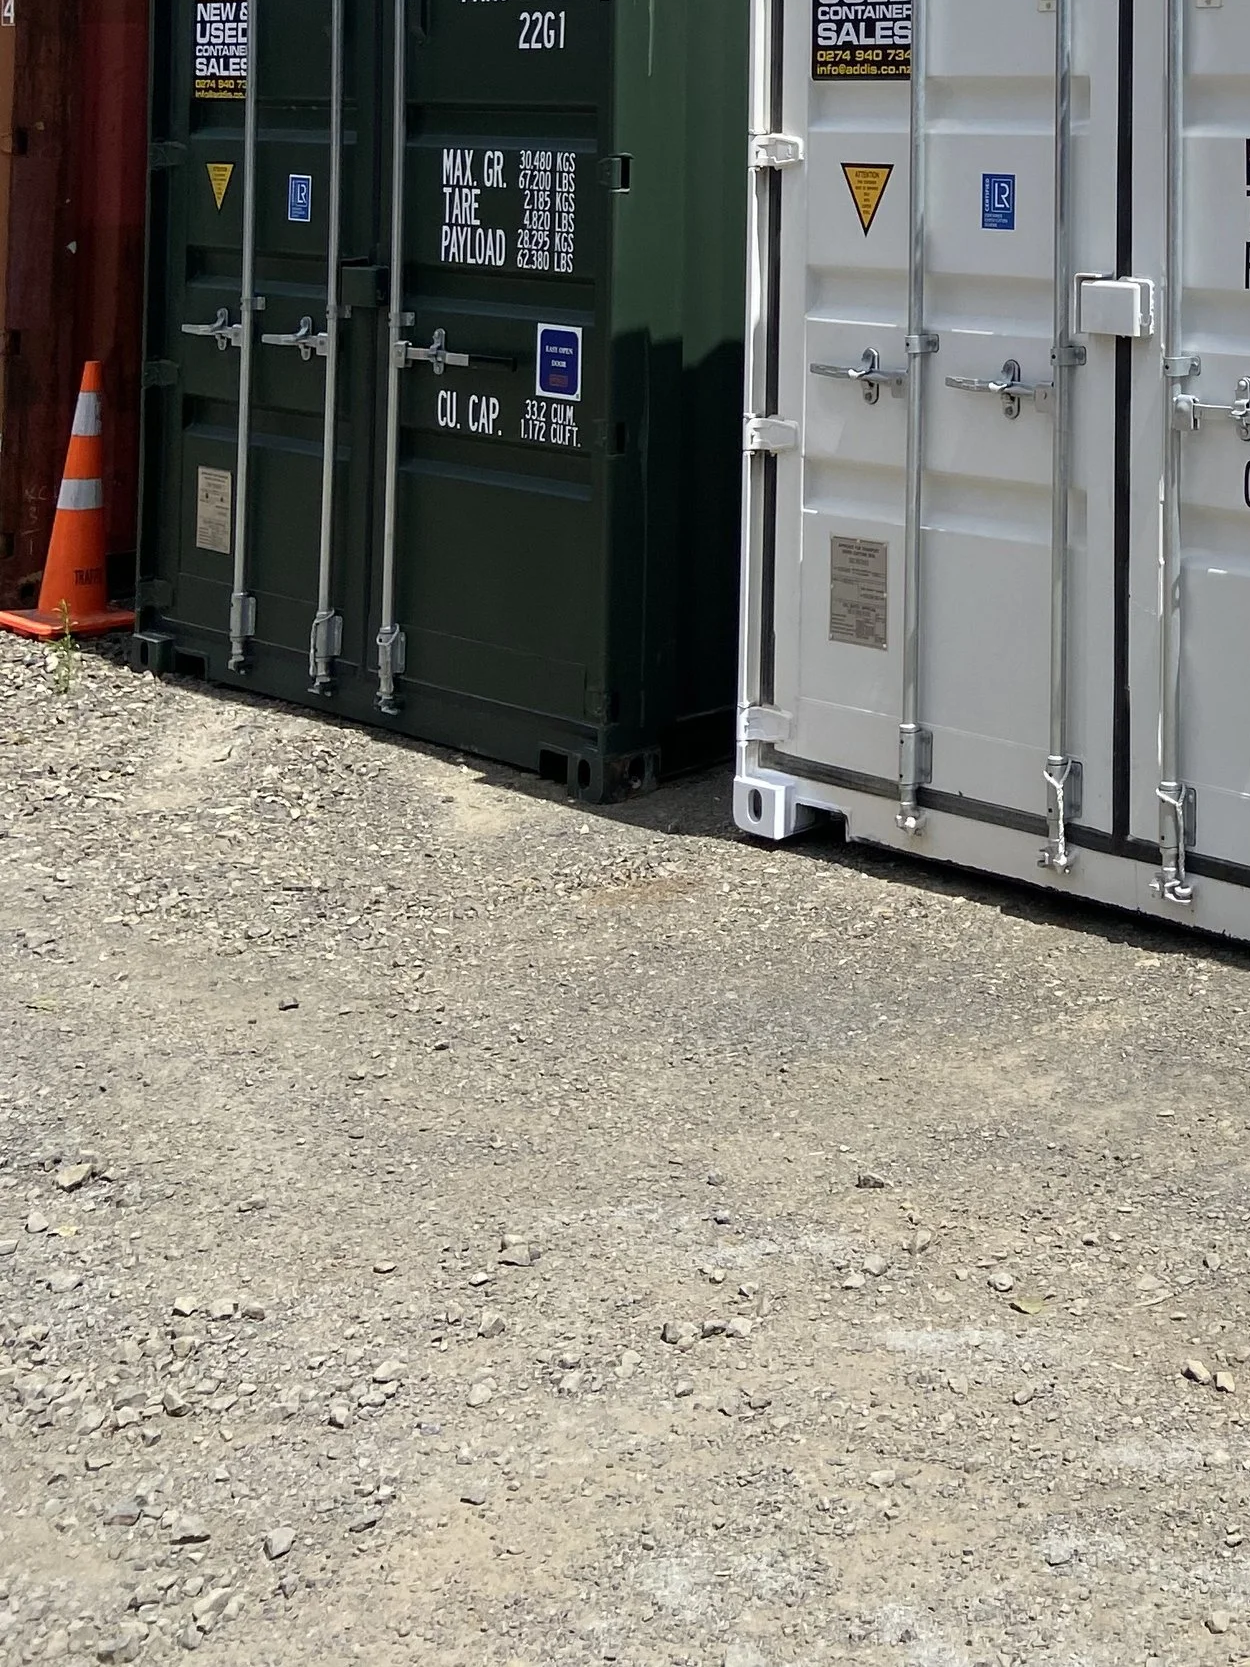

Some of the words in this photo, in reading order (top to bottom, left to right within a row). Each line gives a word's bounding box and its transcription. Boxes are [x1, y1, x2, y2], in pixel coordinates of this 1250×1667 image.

[197, 2, 236, 21] NEW
[518, 10, 565, 49] 22G1
[817, 20, 912, 46] SALES
[196, 45, 247, 56] CONTAINE
[816, 50, 851, 61] 0274
[855, 49, 882, 61] 940
[886, 49, 912, 60] 734
[817, 63, 912, 75] info@addis.co.nz
[442, 149, 477, 186] MAX.
[484, 150, 507, 188] GR.
[556, 152, 576, 172] KGS
[556, 172, 575, 192] LBS
[443, 187, 481, 225] TARE
[555, 192, 575, 212] KGS
[555, 212, 575, 232] LBS
[441, 225, 506, 267] PAYLOAD
[554, 232, 574, 252] KGS
[554, 252, 573, 273] LBS
[437, 389, 460, 429] CU.
[468, 394, 502, 436] CAP.
[525, 399, 546, 421] 33.2
[550, 424, 581, 447] CU.FT.
